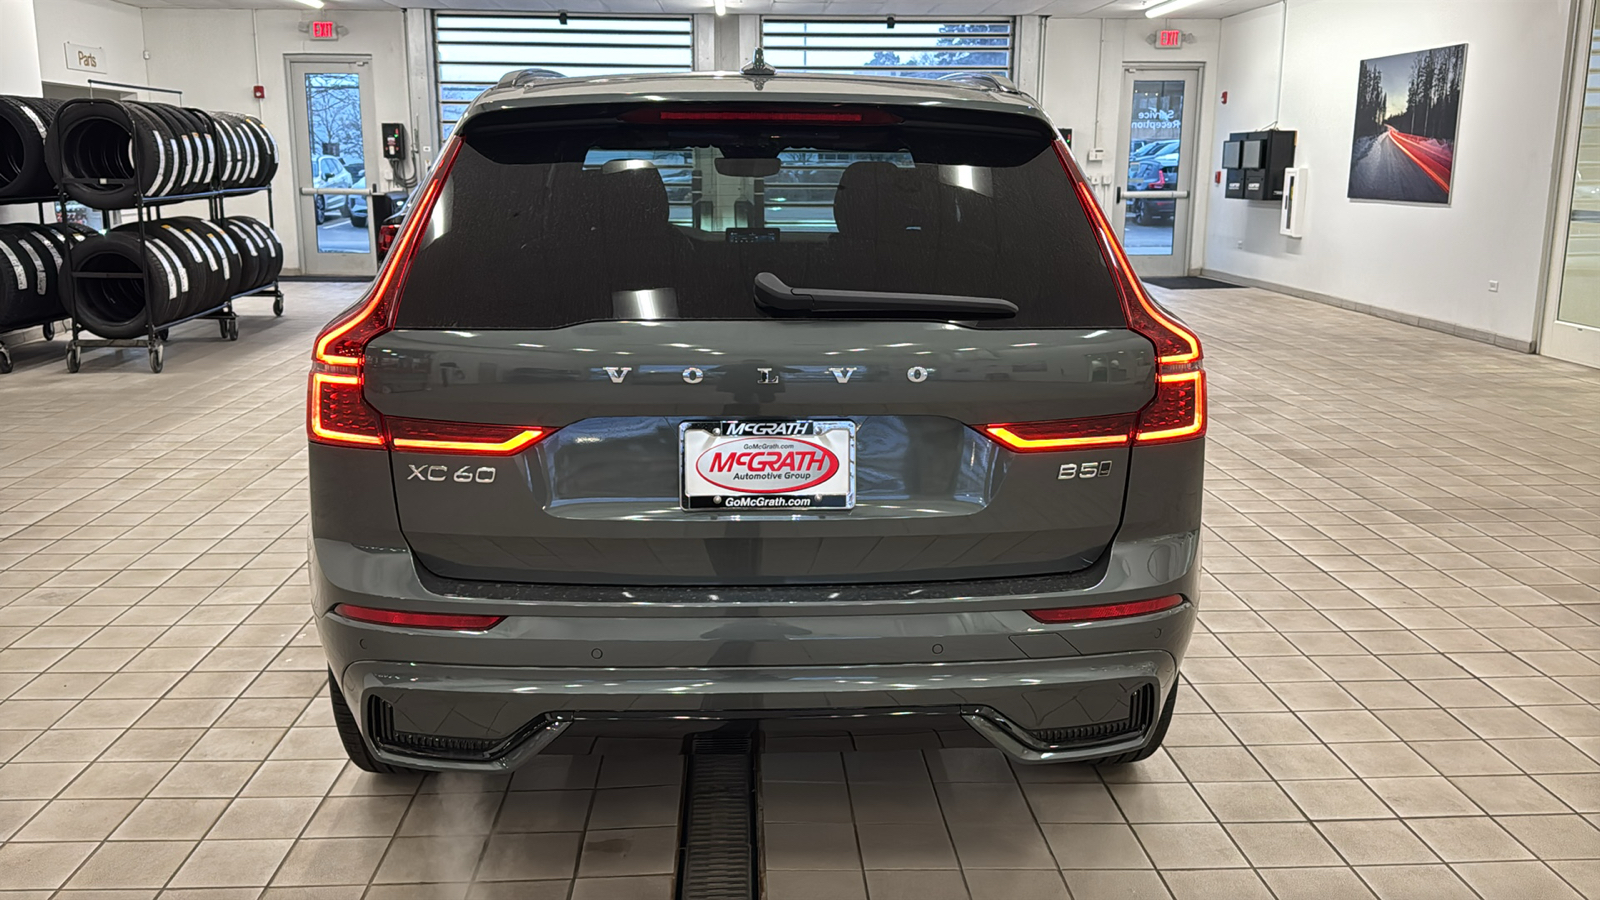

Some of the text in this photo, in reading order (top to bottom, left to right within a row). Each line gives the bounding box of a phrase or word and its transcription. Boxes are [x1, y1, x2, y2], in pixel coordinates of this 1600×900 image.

[313, 21, 333, 37] EXIT
[1160, 30, 1180, 46] EXIT
[78, 50, 97, 67] Parts
[602, 366, 929, 385] VOLVO
[726, 422, 809, 435] McGRATH
[709, 451, 827, 473] McGRATH
[733, 471, 811, 480] Automotive Group
[725, 497, 810, 507] GoMcGrath.com
